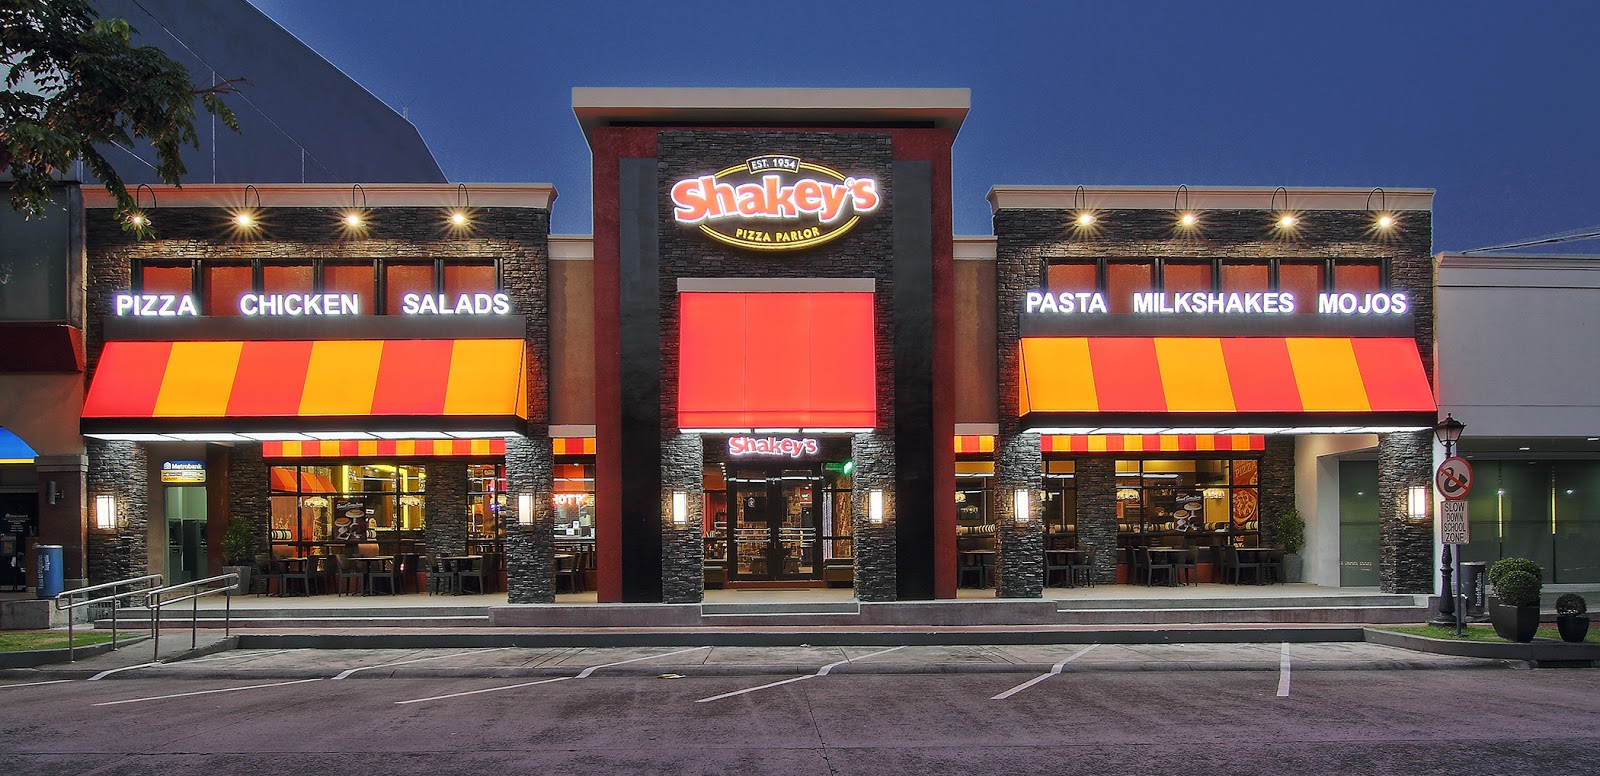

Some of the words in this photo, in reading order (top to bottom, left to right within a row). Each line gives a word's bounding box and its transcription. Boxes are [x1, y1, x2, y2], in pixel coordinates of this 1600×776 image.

[751, 159, 769, 170] EST.
[773, 158, 796, 169] 1954
[671, 175, 879, 223] Shakey's
[735, 228, 771, 242] PIZZA
[776, 226, 820, 241] PARLOR
[116, 294, 197, 316] PIZZA
[240, 294, 359, 316] CHICKEN
[402, 293, 510, 315] SALADS
[1026, 292, 1108, 313] PASTA
[1133, 292, 1295, 313] MILKSHAKES
[1318, 293, 1408, 314] MOJOS
[729, 436, 818, 457] Shakey's
[1444, 503, 1464, 512] SLOW
[1447, 513, 1463, 522] DOWN
[1444, 523, 1466, 532] SCHOOL
[1446, 533, 1464, 541] ZONE
